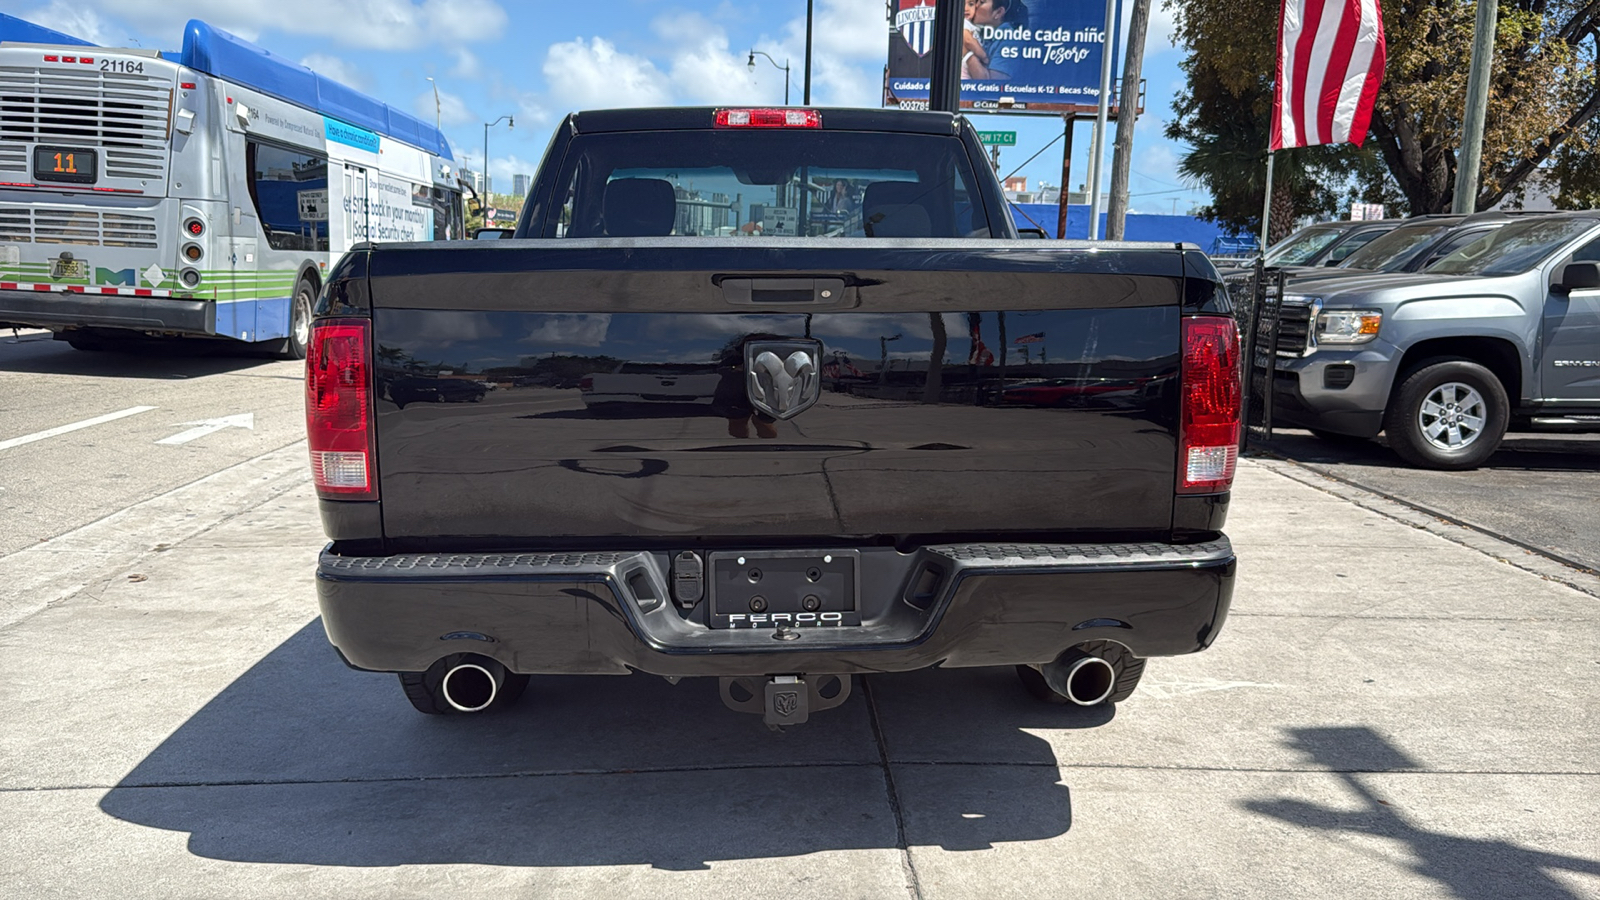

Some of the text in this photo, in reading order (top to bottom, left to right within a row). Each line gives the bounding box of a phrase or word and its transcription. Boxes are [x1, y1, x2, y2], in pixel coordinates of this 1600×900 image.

[897, 8, 935, 26] LINCOLN-M
[983, 25, 1105, 43] Donde cada niño
[1001, 42, 1090, 65] es un Tesoro
[100, 59, 144, 74] 21164
[893, 82, 924, 91] Cuidado
[924, 82, 930, 90] d
[961, 83, 976, 92] VPK
[977, 83, 999, 92] Gratis
[1004, 84, 1036, 94] Escuelas
[1037, 85, 1054, 94] K-12
[1059, 86, 1081, 95] Becas
[328, 123, 340, 137] Have
[344, 128, 358, 143] chronic
[980, 133, 1014, 143] SW 17 Ct
[54, 152, 77, 174] 11
[371, 197, 385, 217] back
[386, 200, 391, 218] in
[392, 206, 403, 223] your
[404, 207, 425, 229] monthly
[378, 222, 400, 241] Security
[401, 225, 415, 241] check
[729, 612, 842, 622] FERCO
